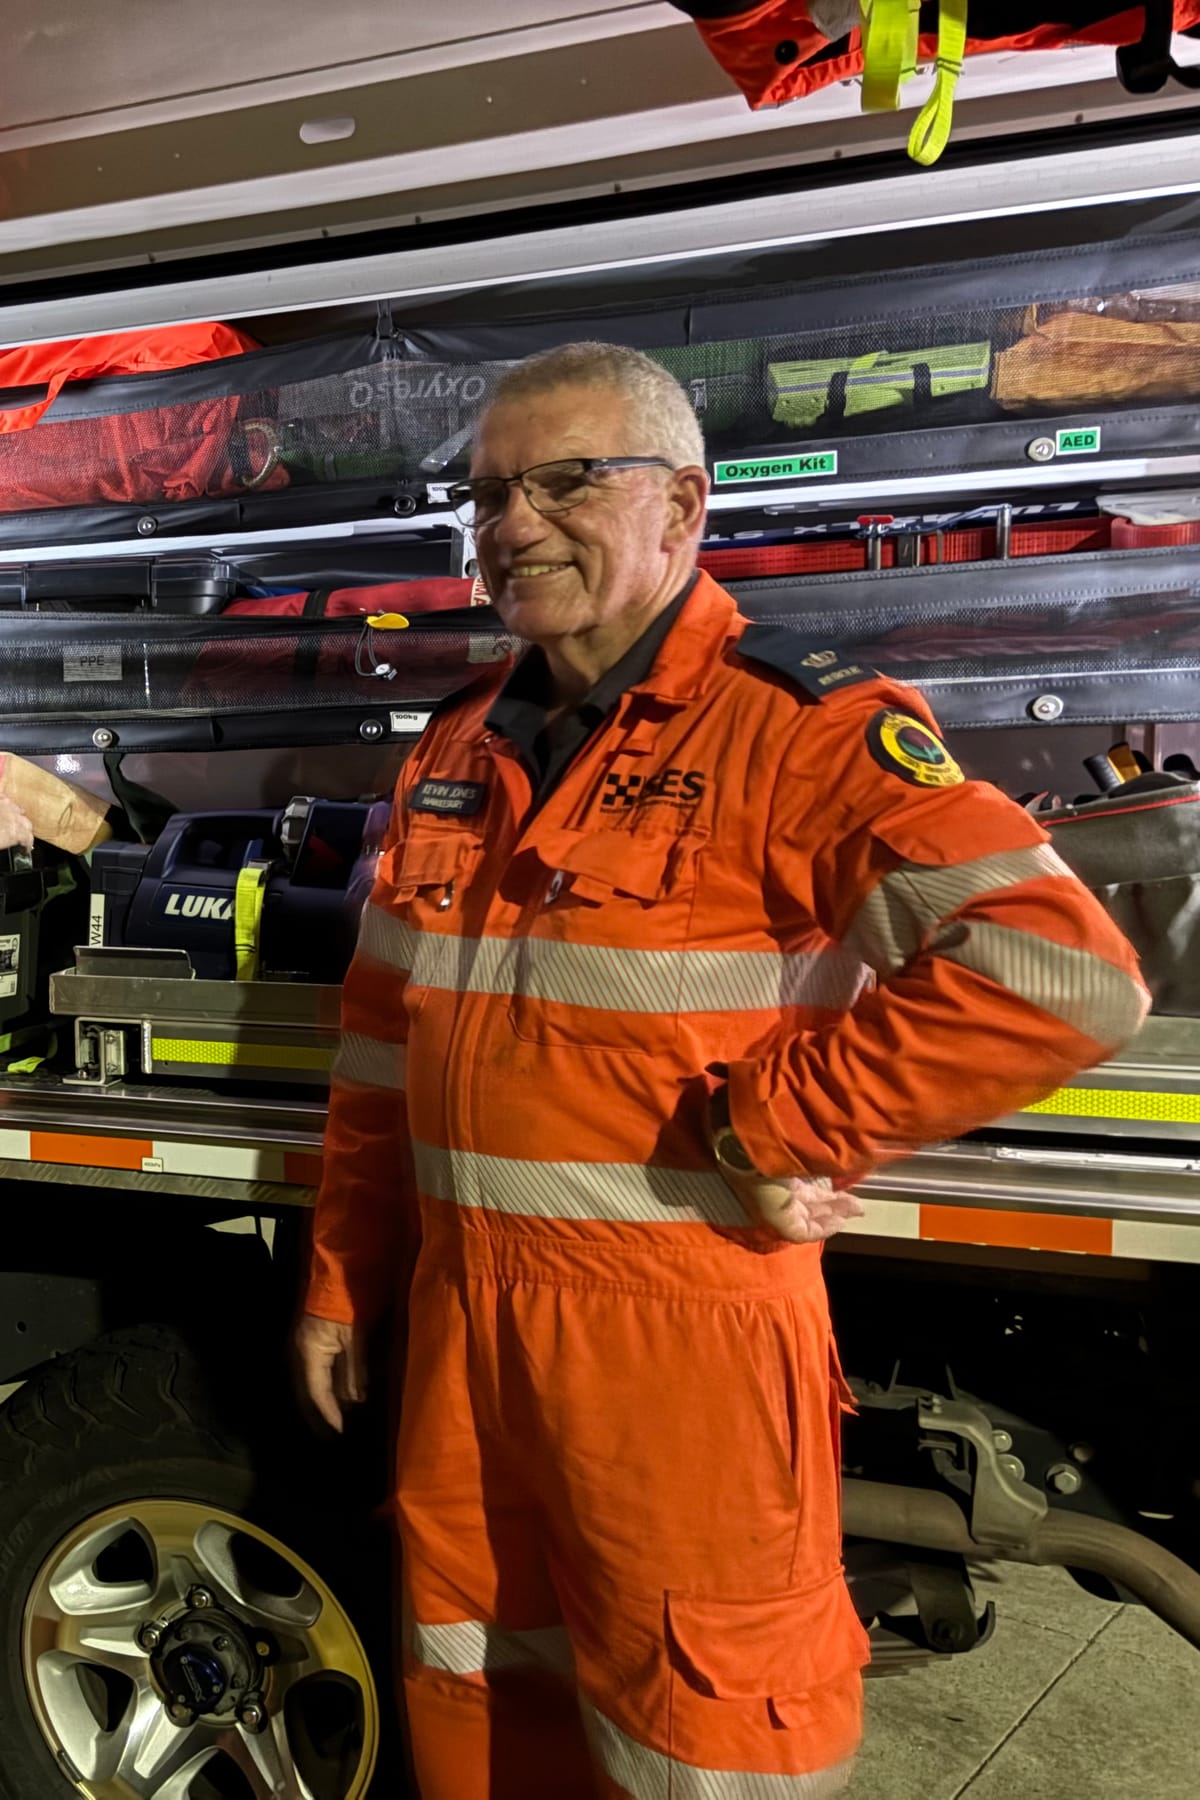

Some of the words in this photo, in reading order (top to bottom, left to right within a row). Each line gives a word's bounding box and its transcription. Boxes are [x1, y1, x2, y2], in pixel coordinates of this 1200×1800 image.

[1062, 435, 1094, 448] AED
[725, 463, 793, 478] Oxygen
[799, 457, 826, 471] Kit
[164, 893, 235, 920] LUKA
[91, 915, 103, 946] W44
